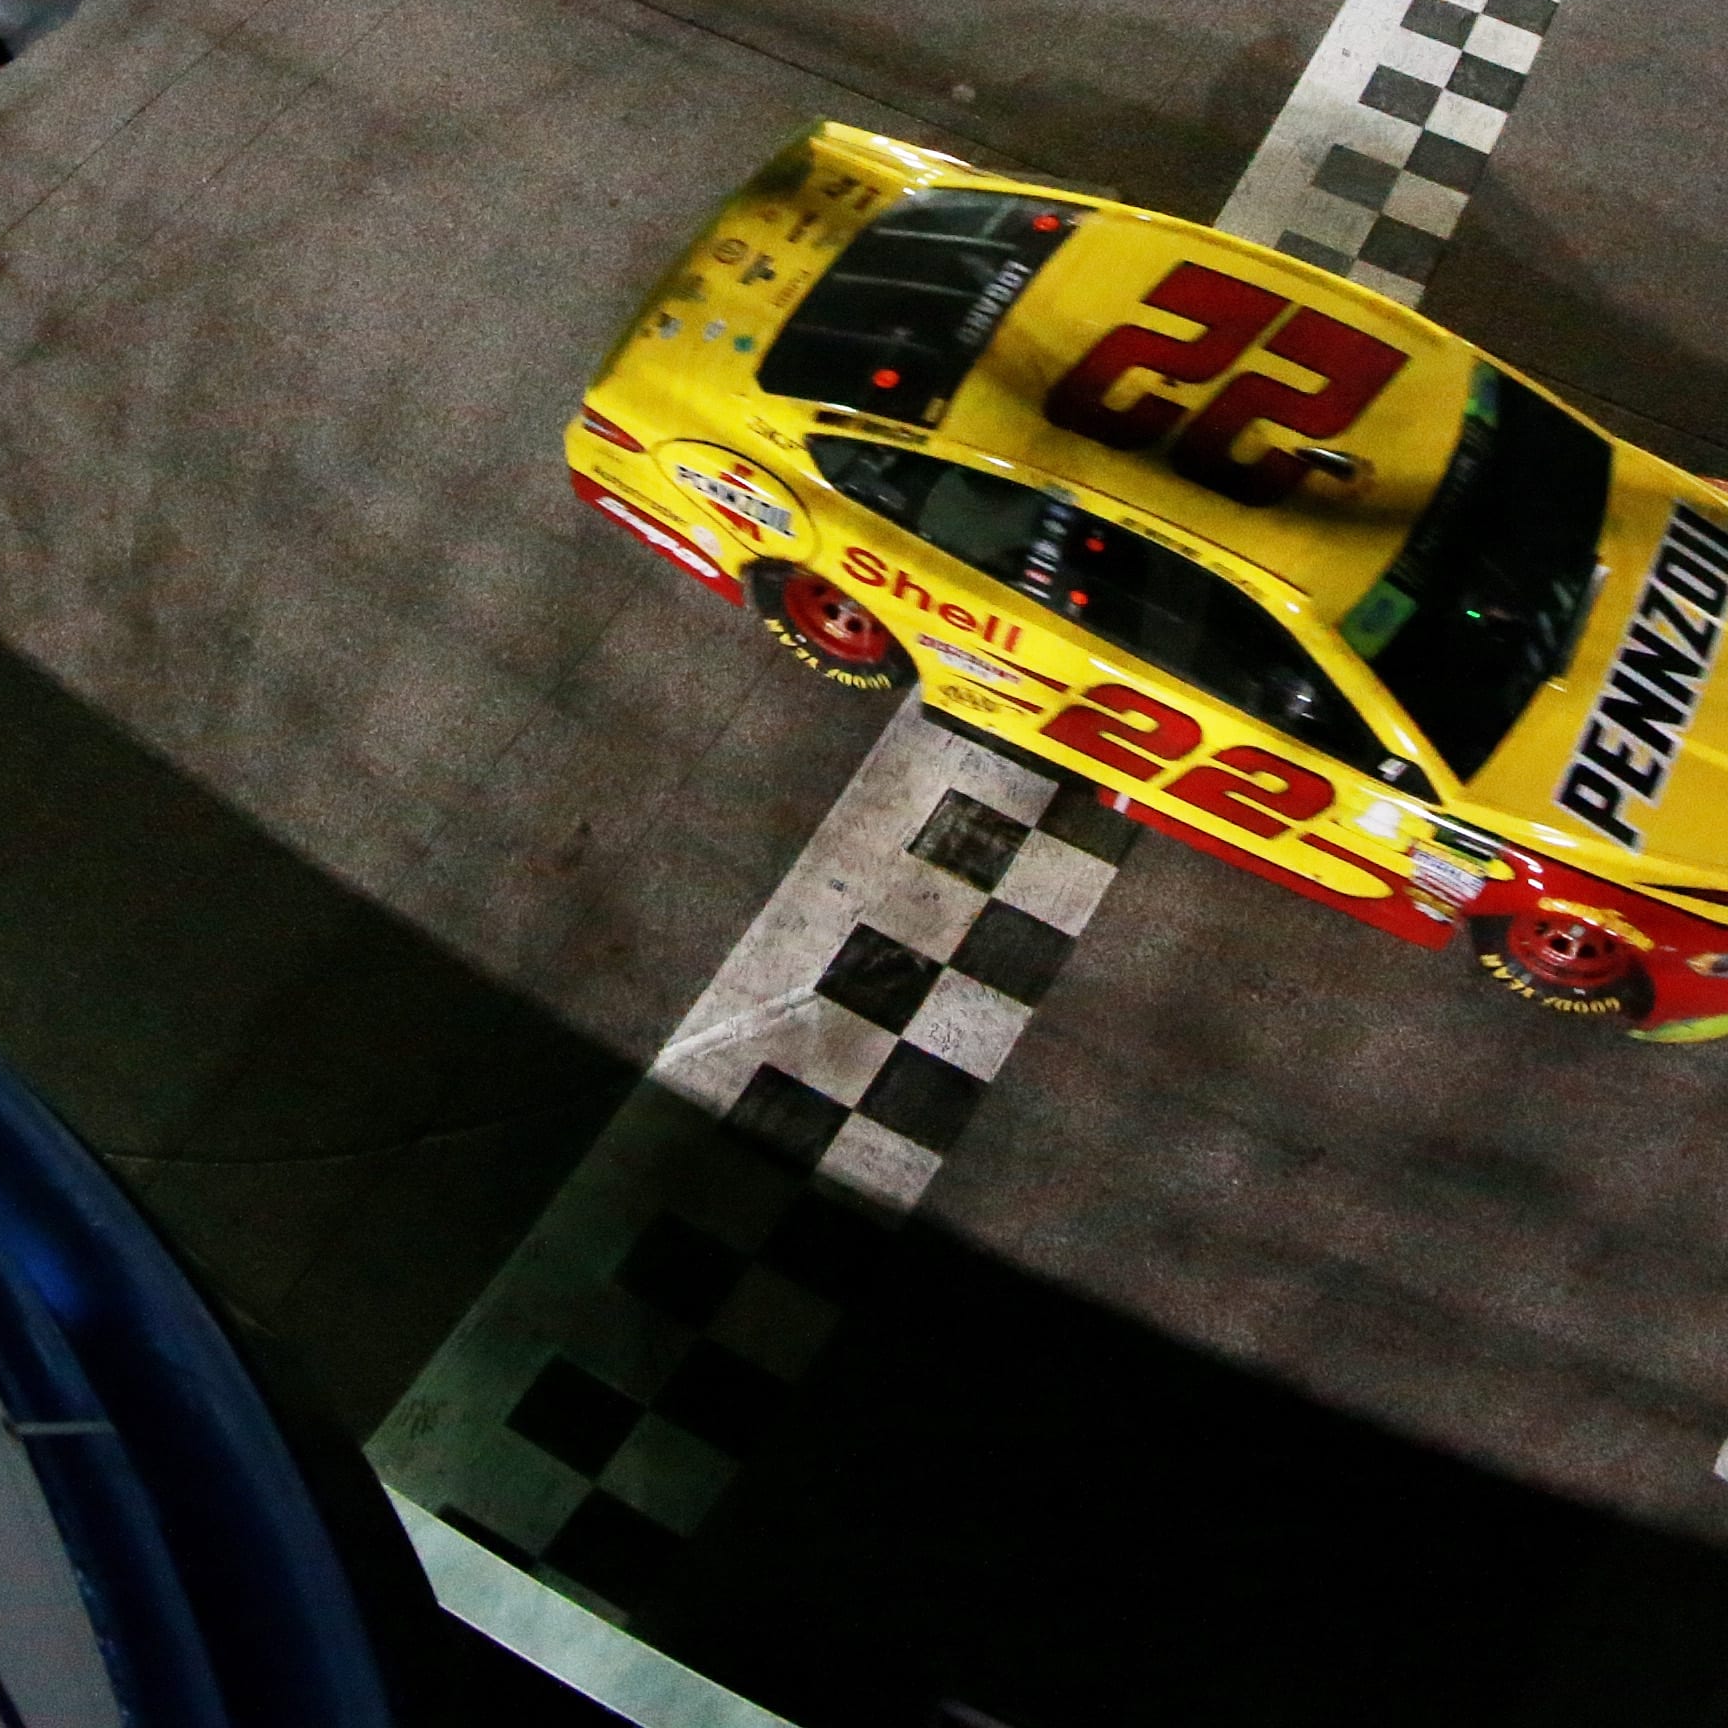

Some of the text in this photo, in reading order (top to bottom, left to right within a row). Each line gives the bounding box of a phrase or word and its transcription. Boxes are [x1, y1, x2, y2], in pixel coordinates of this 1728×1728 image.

[1044, 259, 1400, 507] 22
[840, 543, 1026, 657] Shell
[1040, 681, 1337, 841] 22
